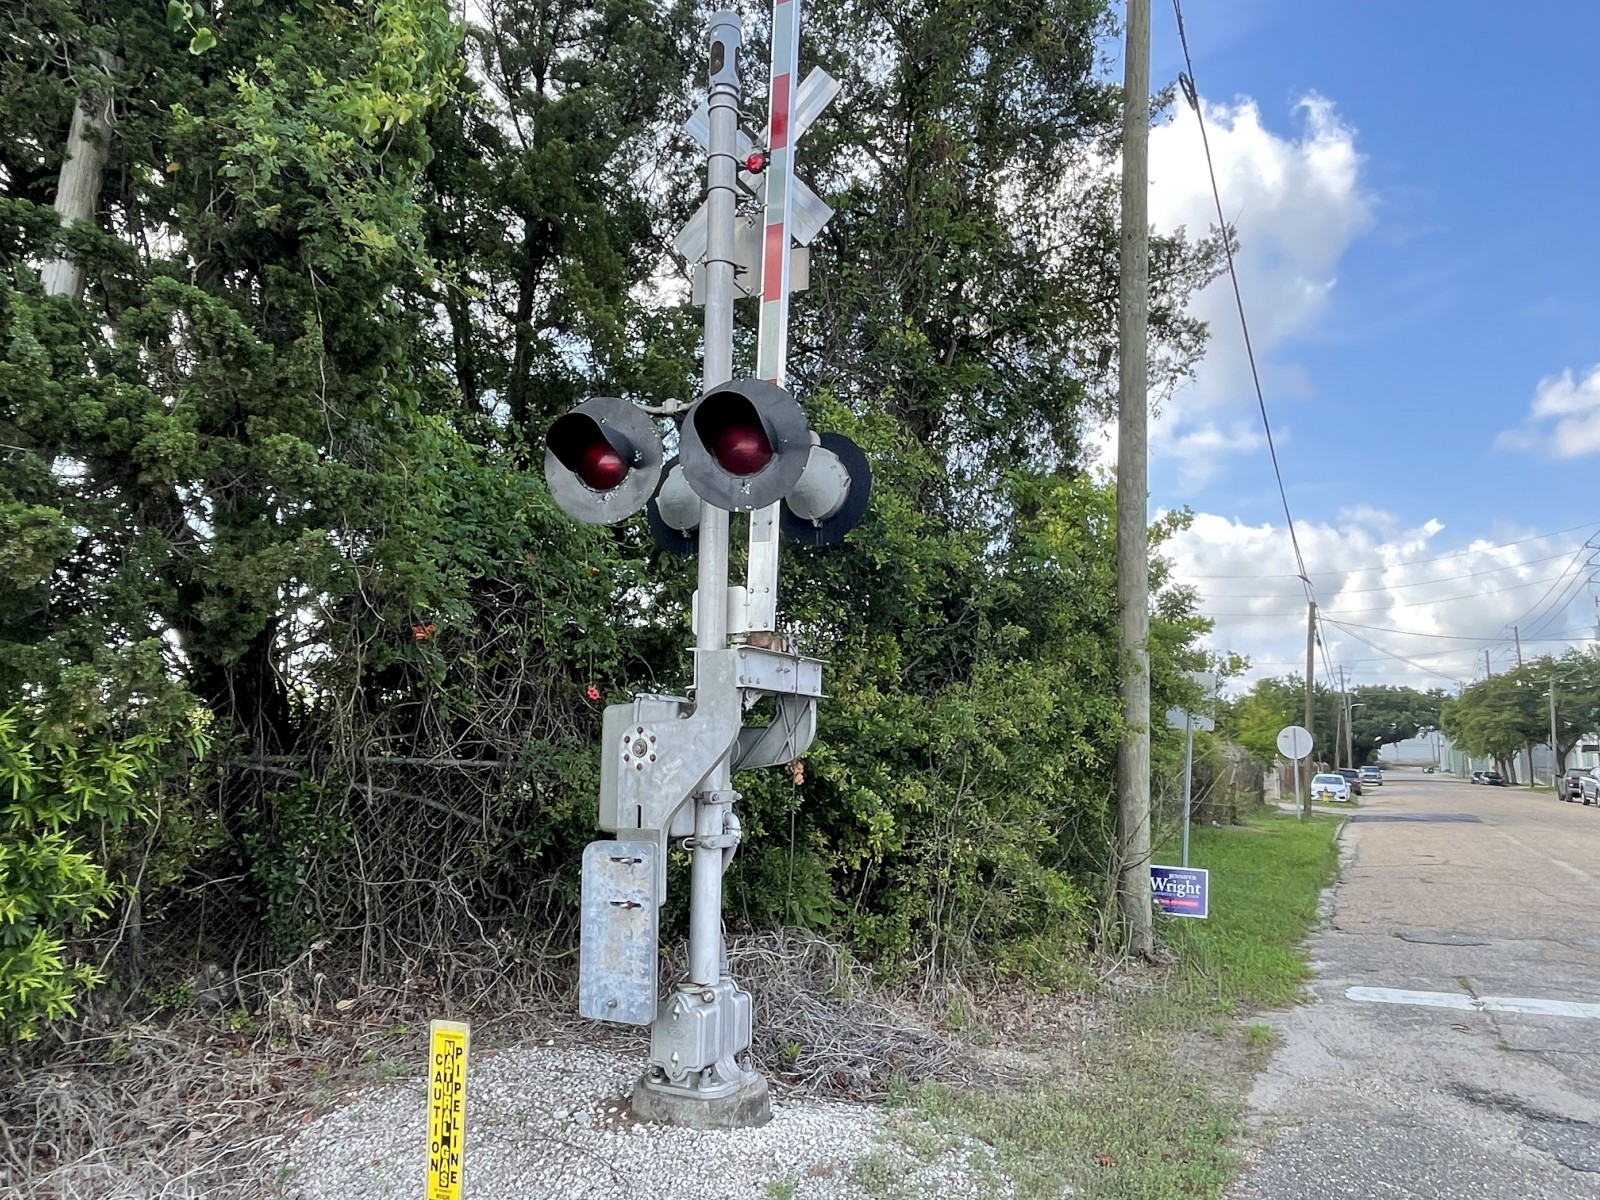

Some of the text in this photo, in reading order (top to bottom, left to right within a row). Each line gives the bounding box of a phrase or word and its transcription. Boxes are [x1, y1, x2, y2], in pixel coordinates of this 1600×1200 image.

[1150, 877, 1201, 897] Wright
[431, 1054, 443, 1172] CAUTION
[442, 1041, 454, 1137] NATURAL
[450, 1047, 463, 1184] PIPELINE
[440, 1145, 450, 1187] GAS
